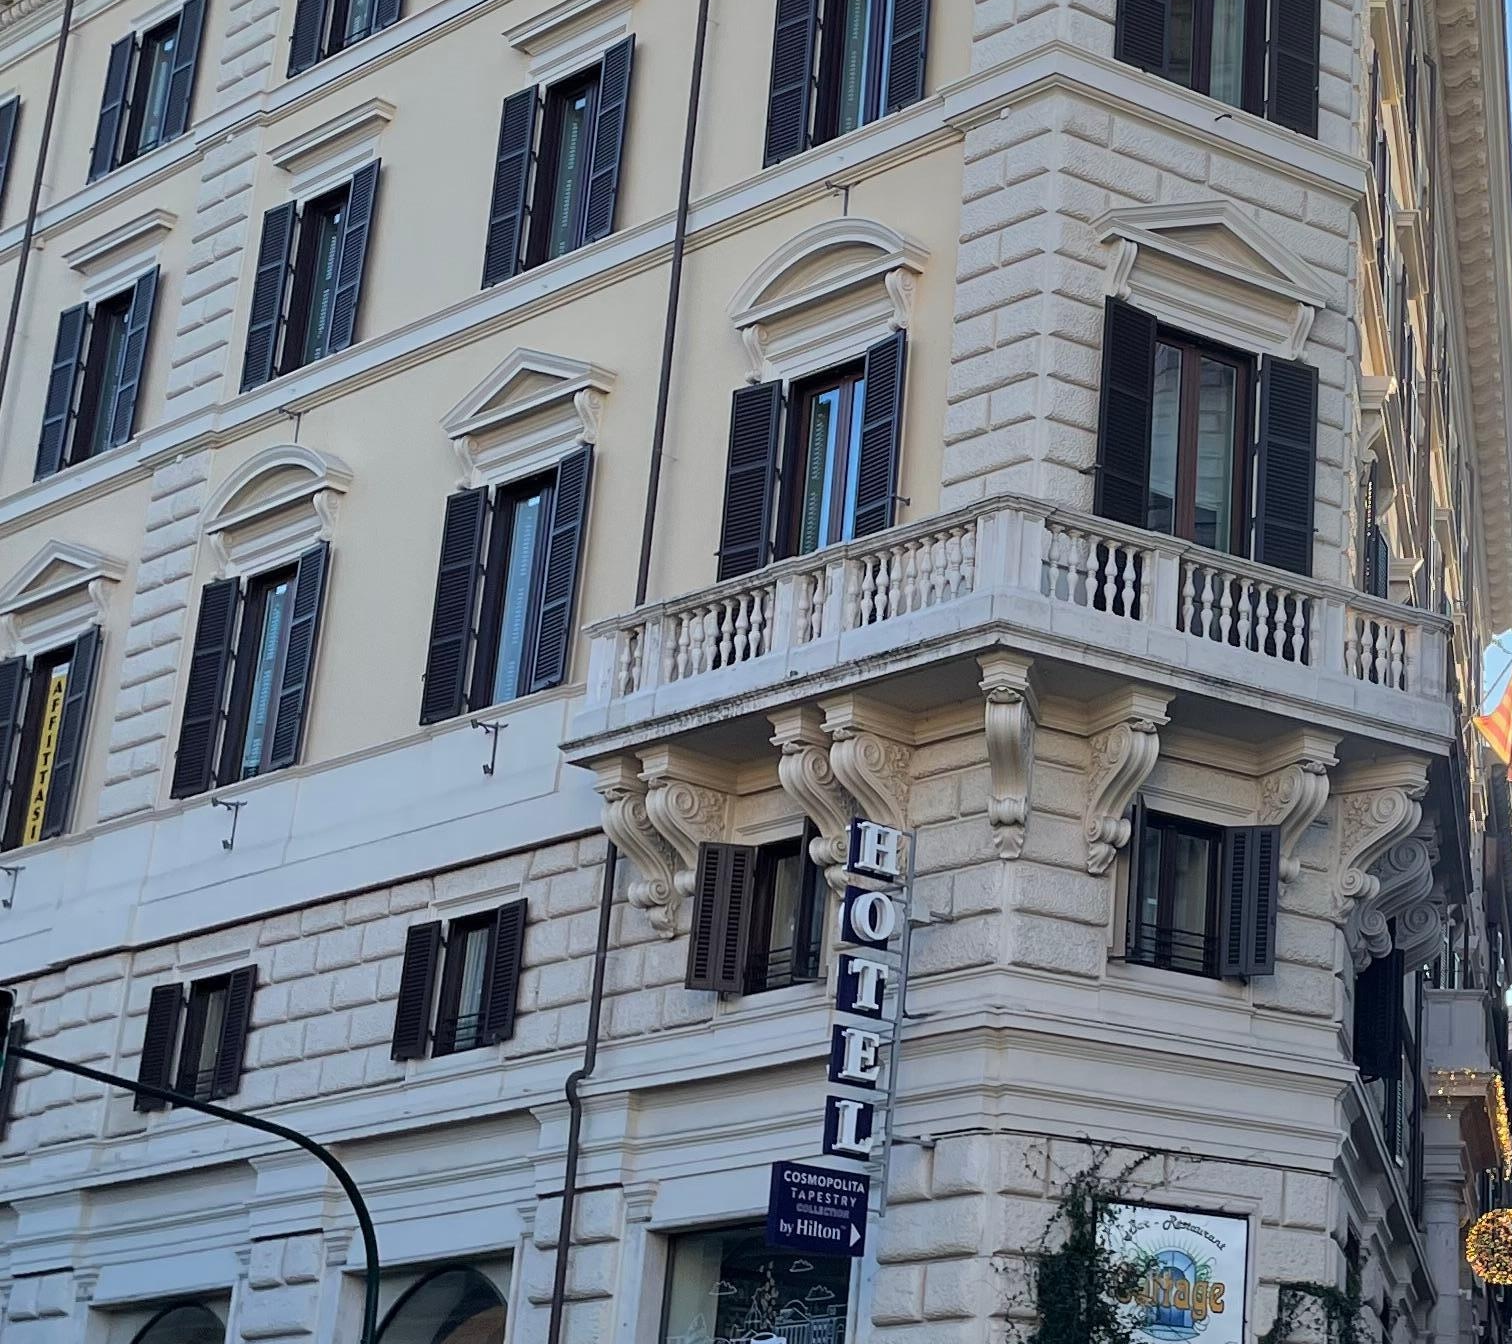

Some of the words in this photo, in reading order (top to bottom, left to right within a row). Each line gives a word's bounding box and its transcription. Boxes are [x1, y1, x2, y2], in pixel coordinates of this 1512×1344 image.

[29, 680, 63, 840] AFFITTASI
[832, 821, 902, 1154] HOTEL
[790, 1187, 857, 1208] TAPESTRY
[795, 1203, 850, 1219] COLLECTION
[780, 1218, 794, 1237] by
[796, 1218, 841, 1240] Hilton
